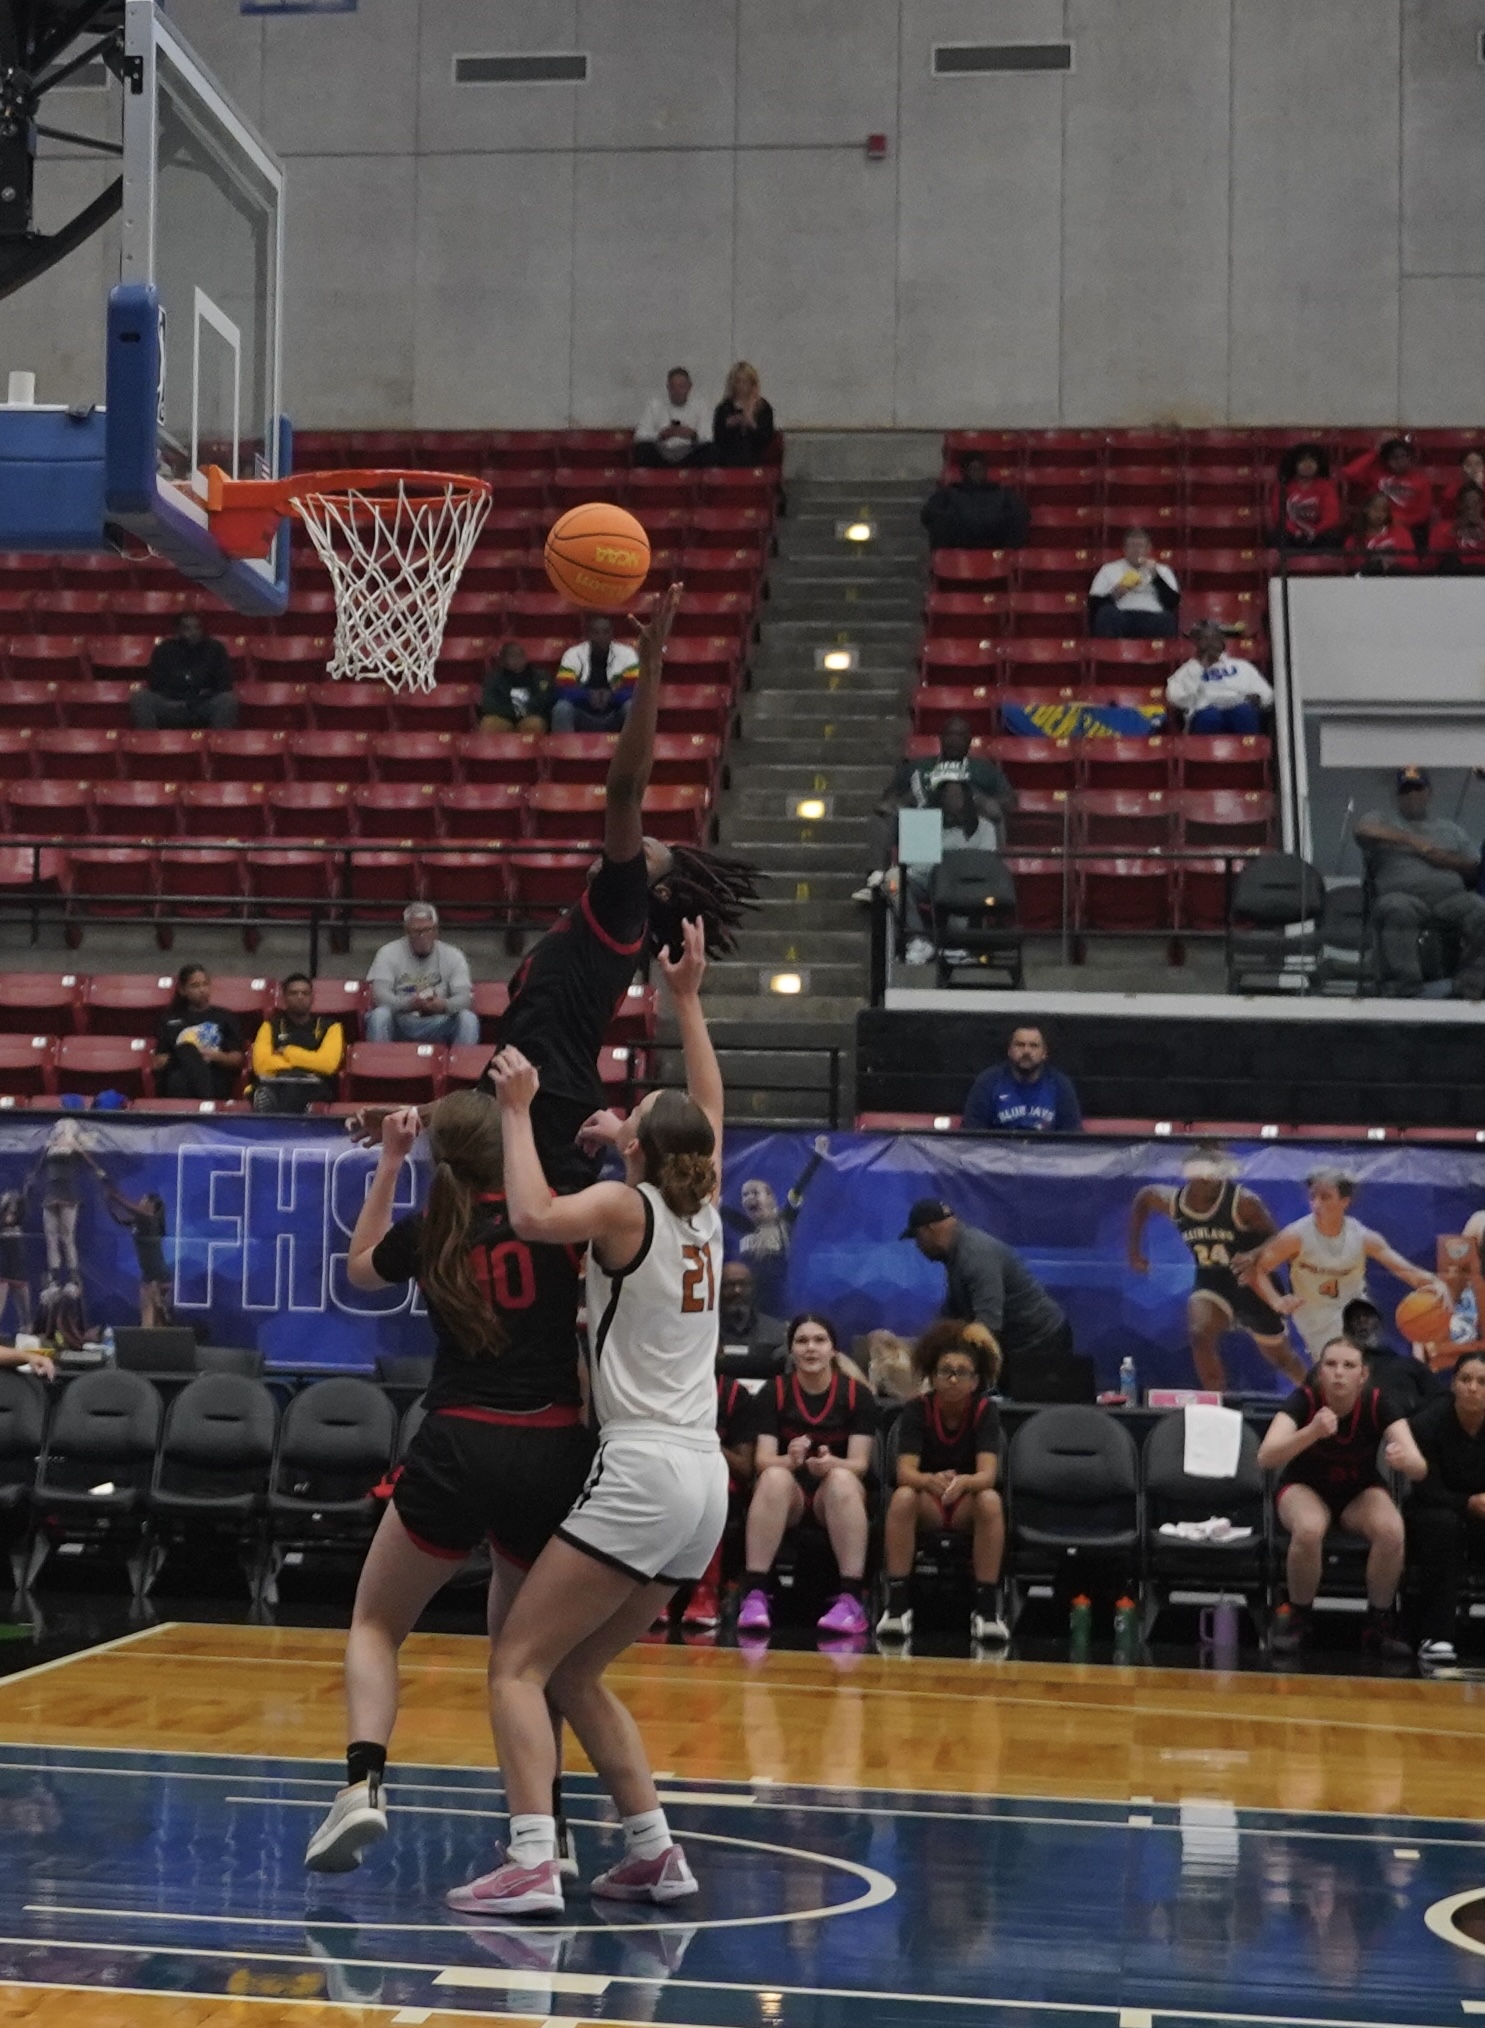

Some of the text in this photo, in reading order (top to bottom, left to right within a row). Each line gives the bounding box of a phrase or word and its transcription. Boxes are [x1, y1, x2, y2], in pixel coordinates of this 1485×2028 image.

[997, 1105, 1027, 1123] BLUE
[173, 1143, 429, 1317] FHS
[680, 1241, 716, 1314] 21
[1319, 1279, 1339, 1298] 4
